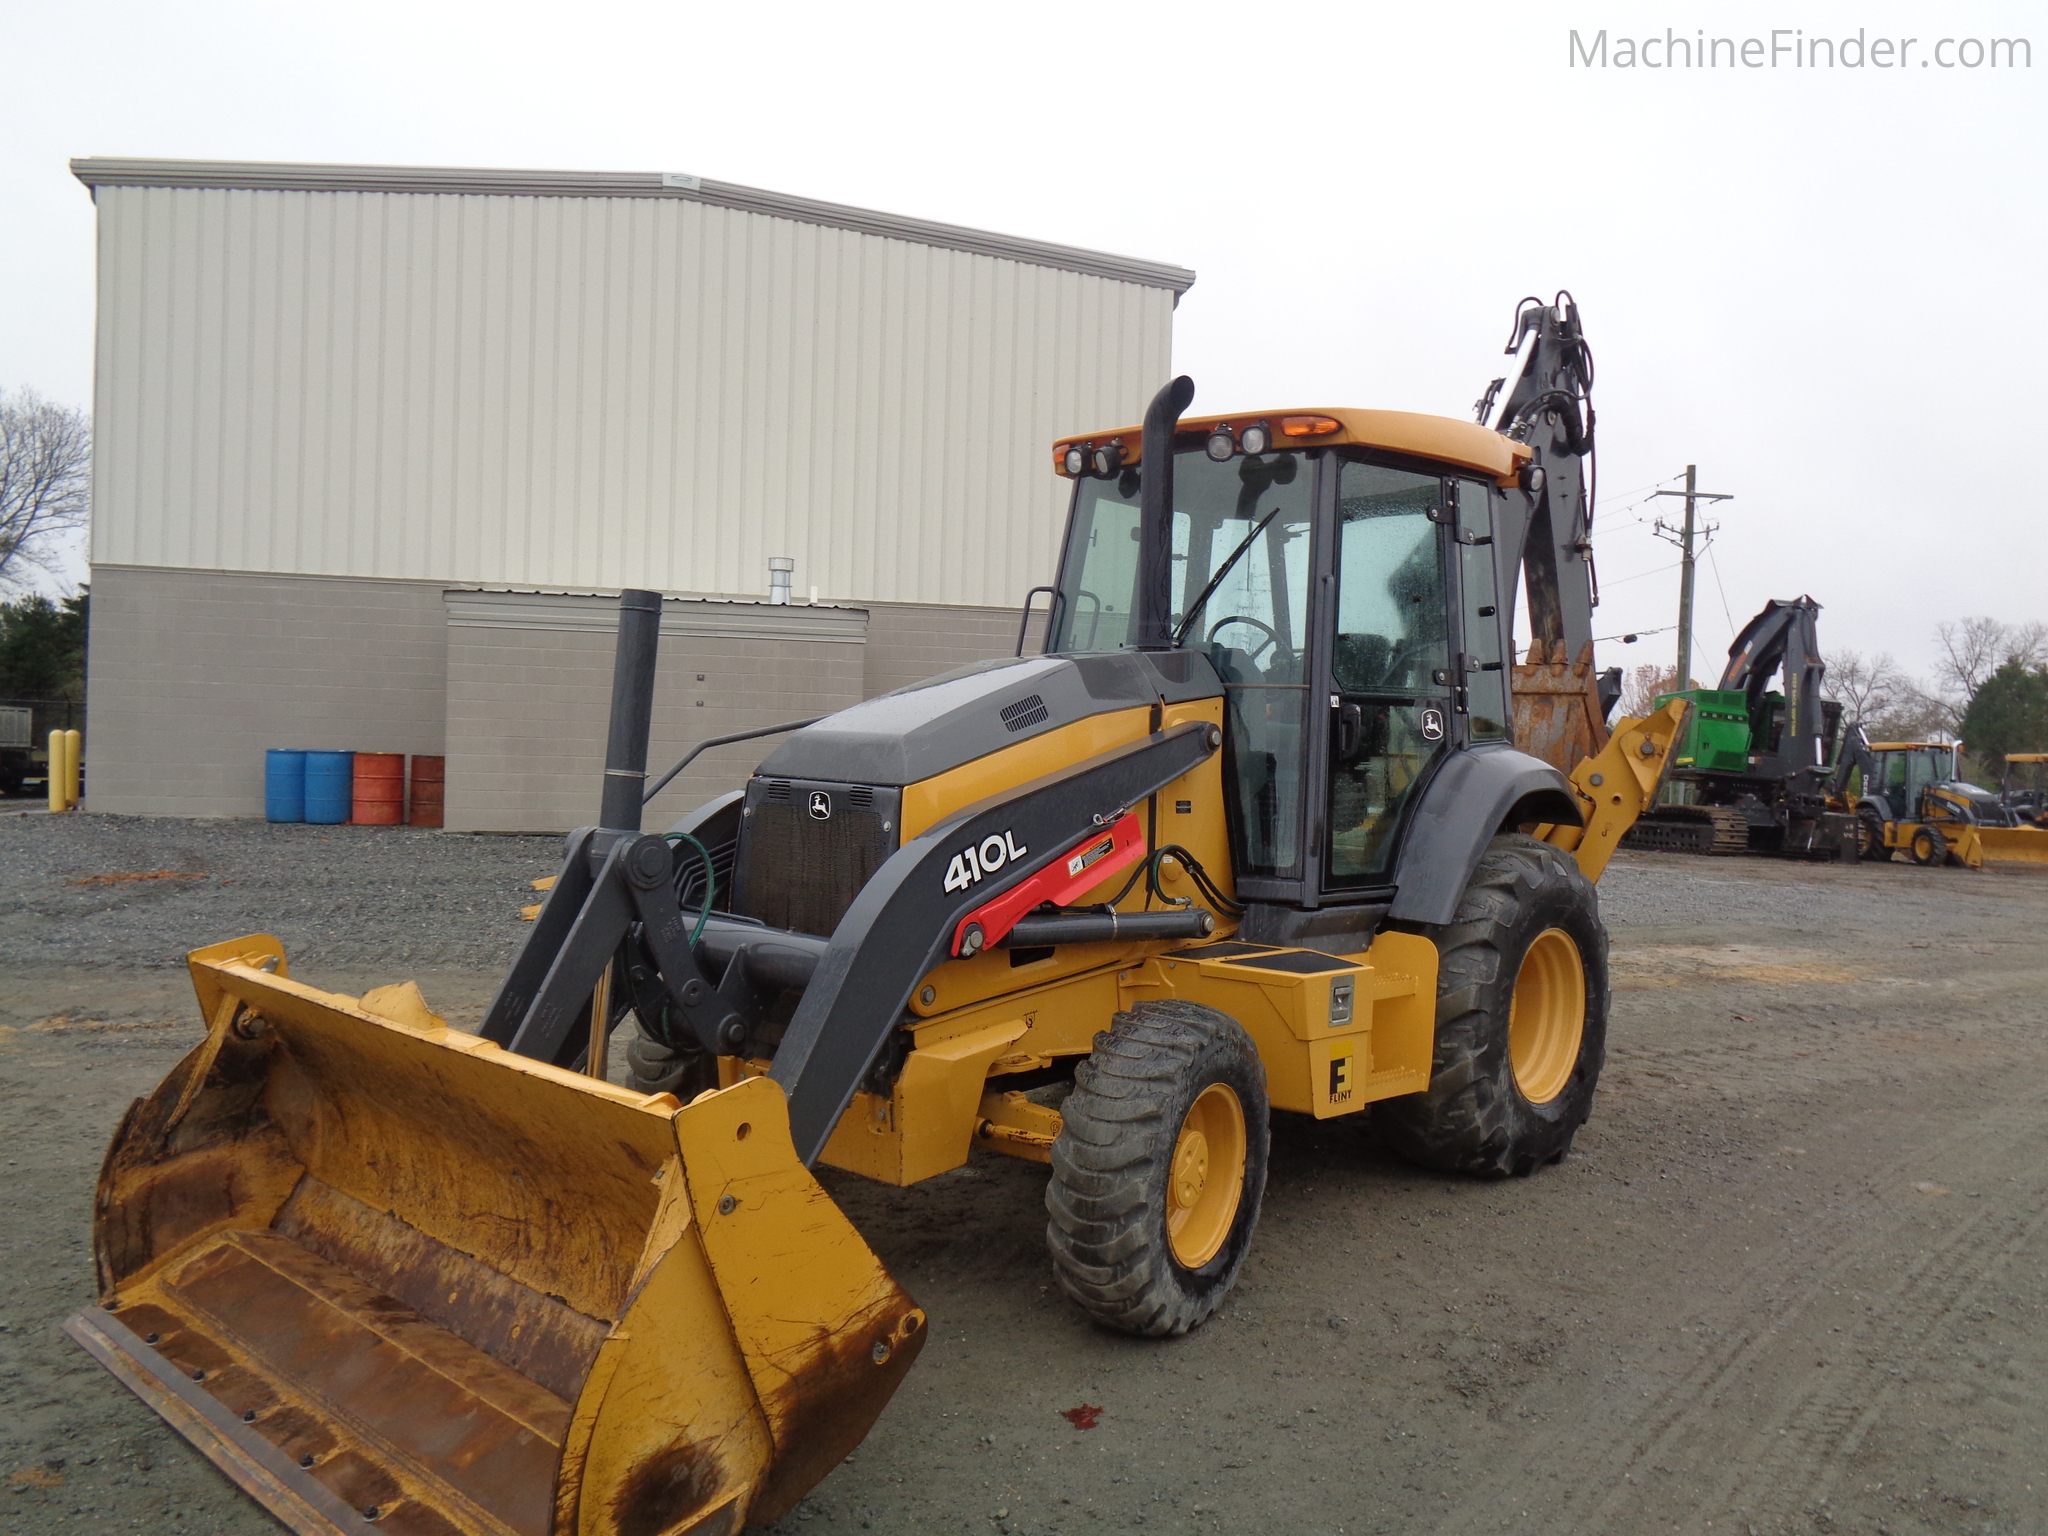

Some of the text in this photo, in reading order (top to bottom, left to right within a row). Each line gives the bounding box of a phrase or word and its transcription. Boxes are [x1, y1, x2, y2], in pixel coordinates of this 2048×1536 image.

[943, 830, 1027, 892] 410L
[1330, 1058, 1346, 1095] F
[1330, 1090, 1352, 1104] FLINT
